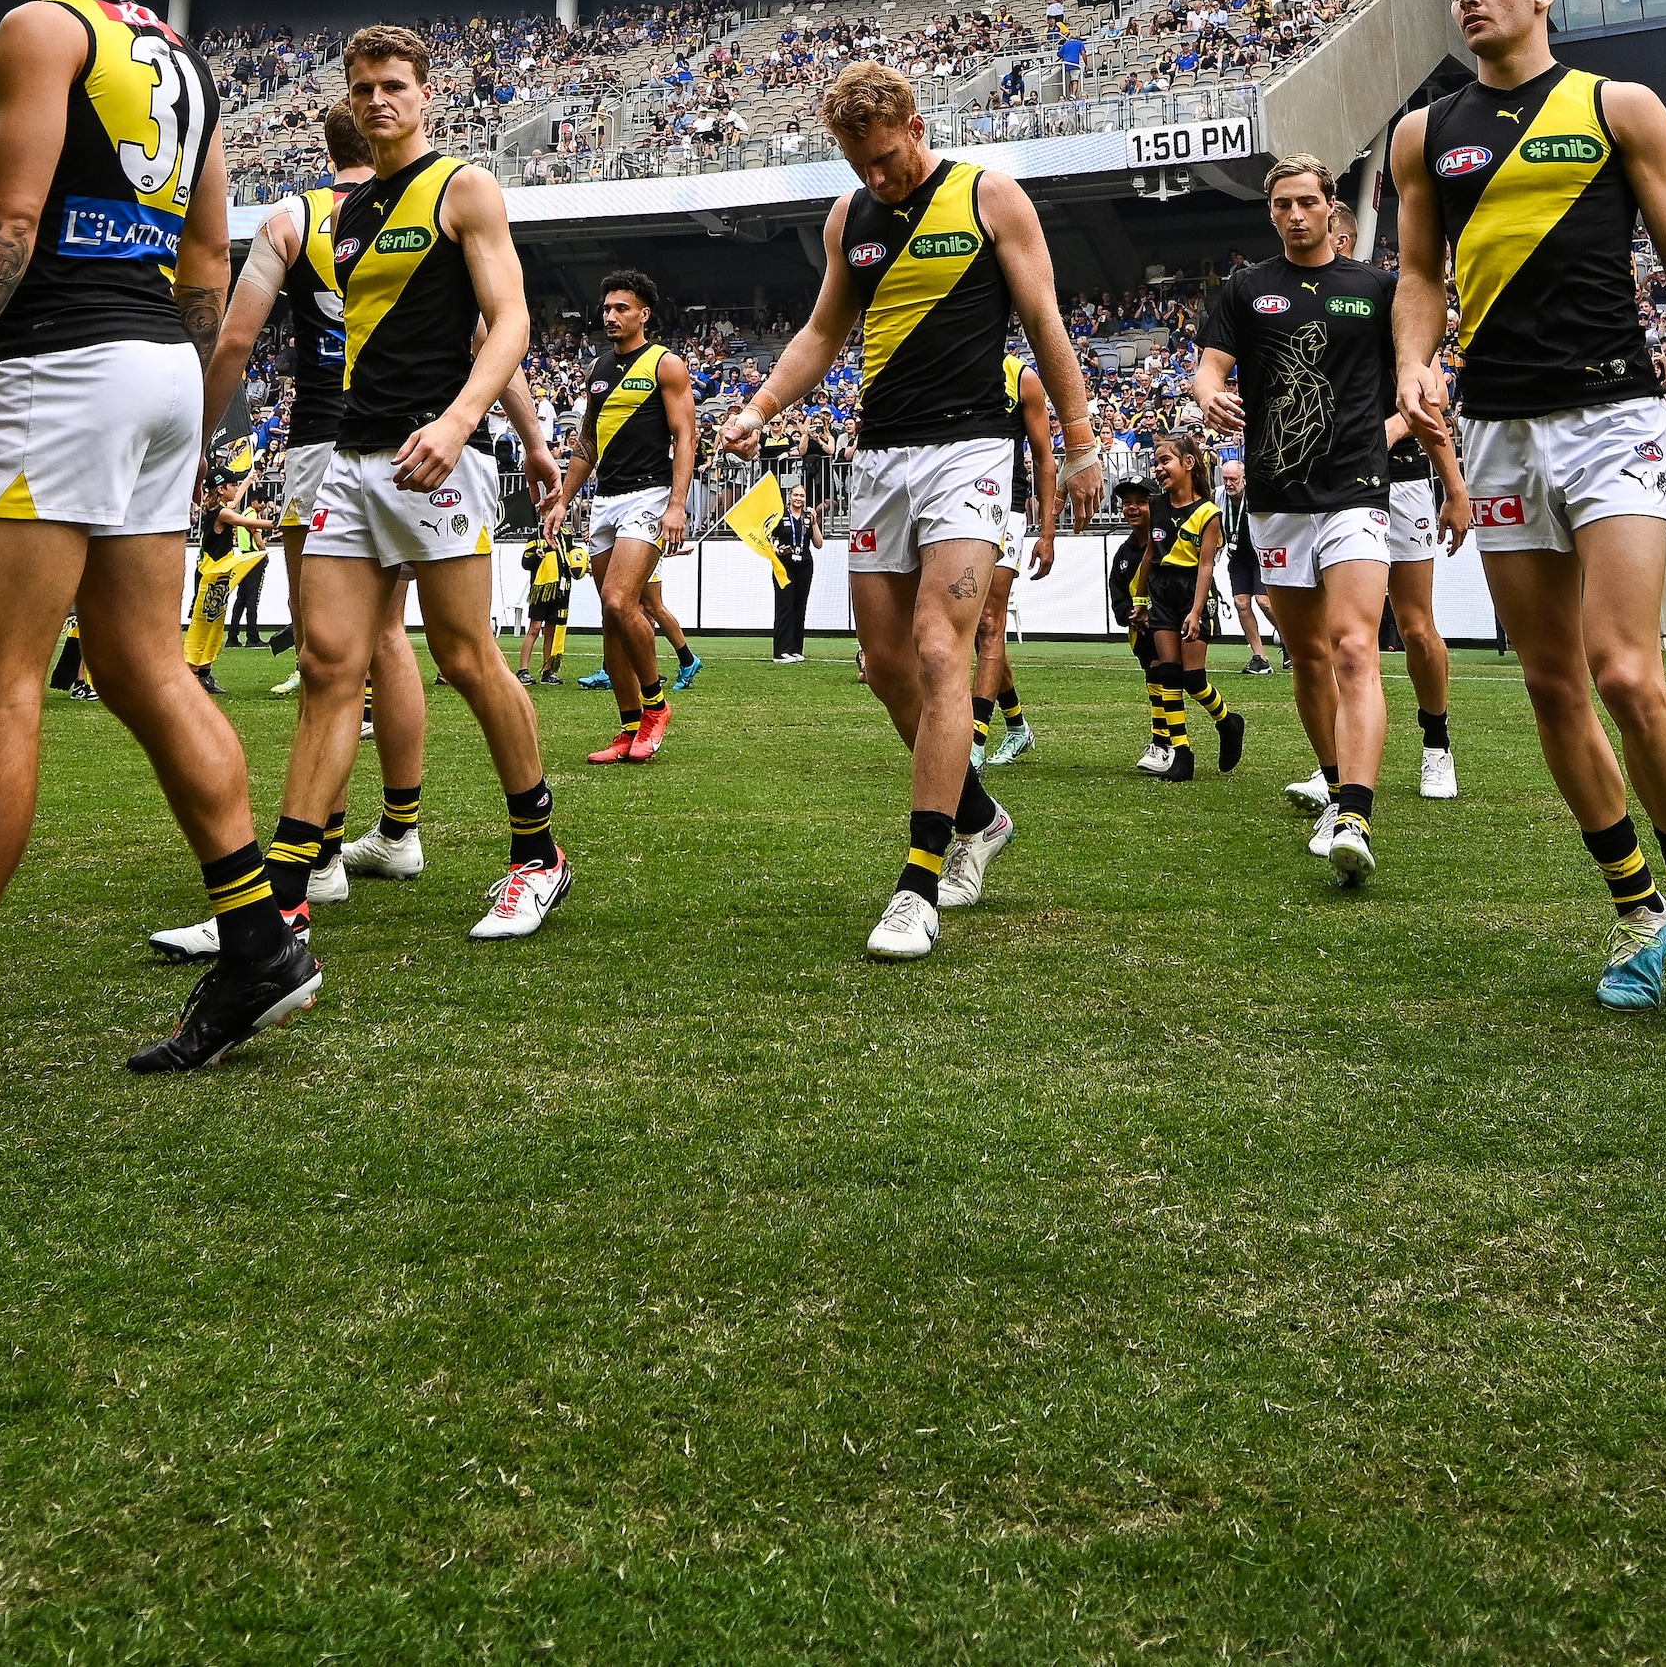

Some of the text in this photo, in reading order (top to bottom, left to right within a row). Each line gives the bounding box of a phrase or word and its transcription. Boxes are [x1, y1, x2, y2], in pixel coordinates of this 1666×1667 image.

[118, 35, 206, 207] 31
[1132, 124, 1245, 163] 1:50 PM
[1552, 139, 1597, 159] nib
[1441, 151, 1486, 173] AFL
[393, 231, 425, 250] nib
[935, 235, 973, 254] nib
[335, 243, 356, 261] AFL
[852, 246, 882, 262] AFL
[1256, 299, 1288, 310] AFL
[1345, 300, 1371, 316] nib
[633, 379, 652, 390] nib
[977, 482, 999, 495] AFL
[432, 492, 461, 504] AFL
[1470, 498, 1518, 526] FC
